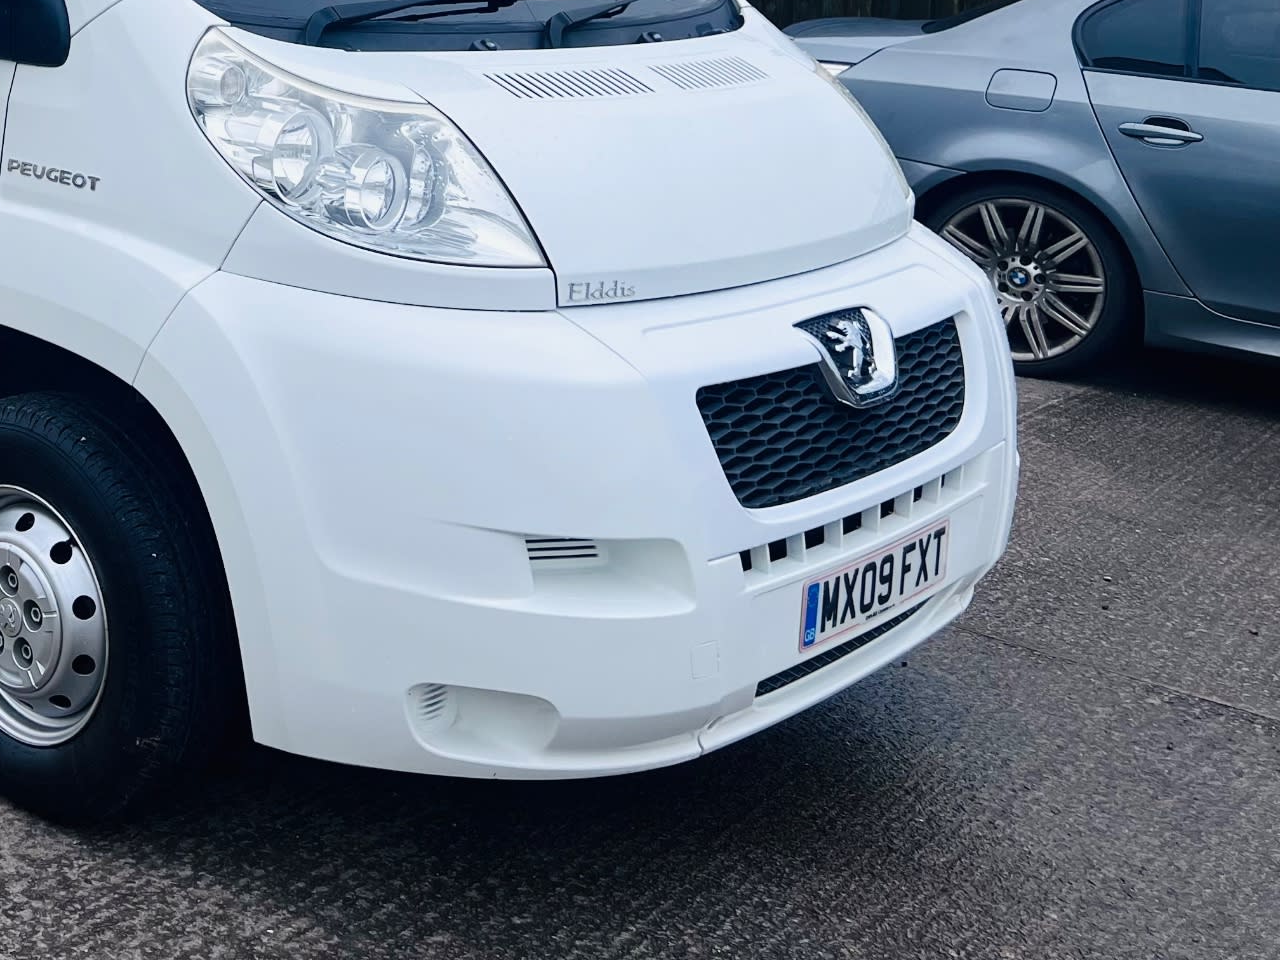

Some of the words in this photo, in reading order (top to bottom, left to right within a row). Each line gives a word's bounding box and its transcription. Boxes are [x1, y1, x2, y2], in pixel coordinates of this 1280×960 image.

[7, 158, 101, 192] PEUGEOT
[567, 279, 637, 303] Elddis
[819, 553, 895, 634] MX09
[898, 525, 947, 596] FXT
[804, 627, 816, 643] GB
